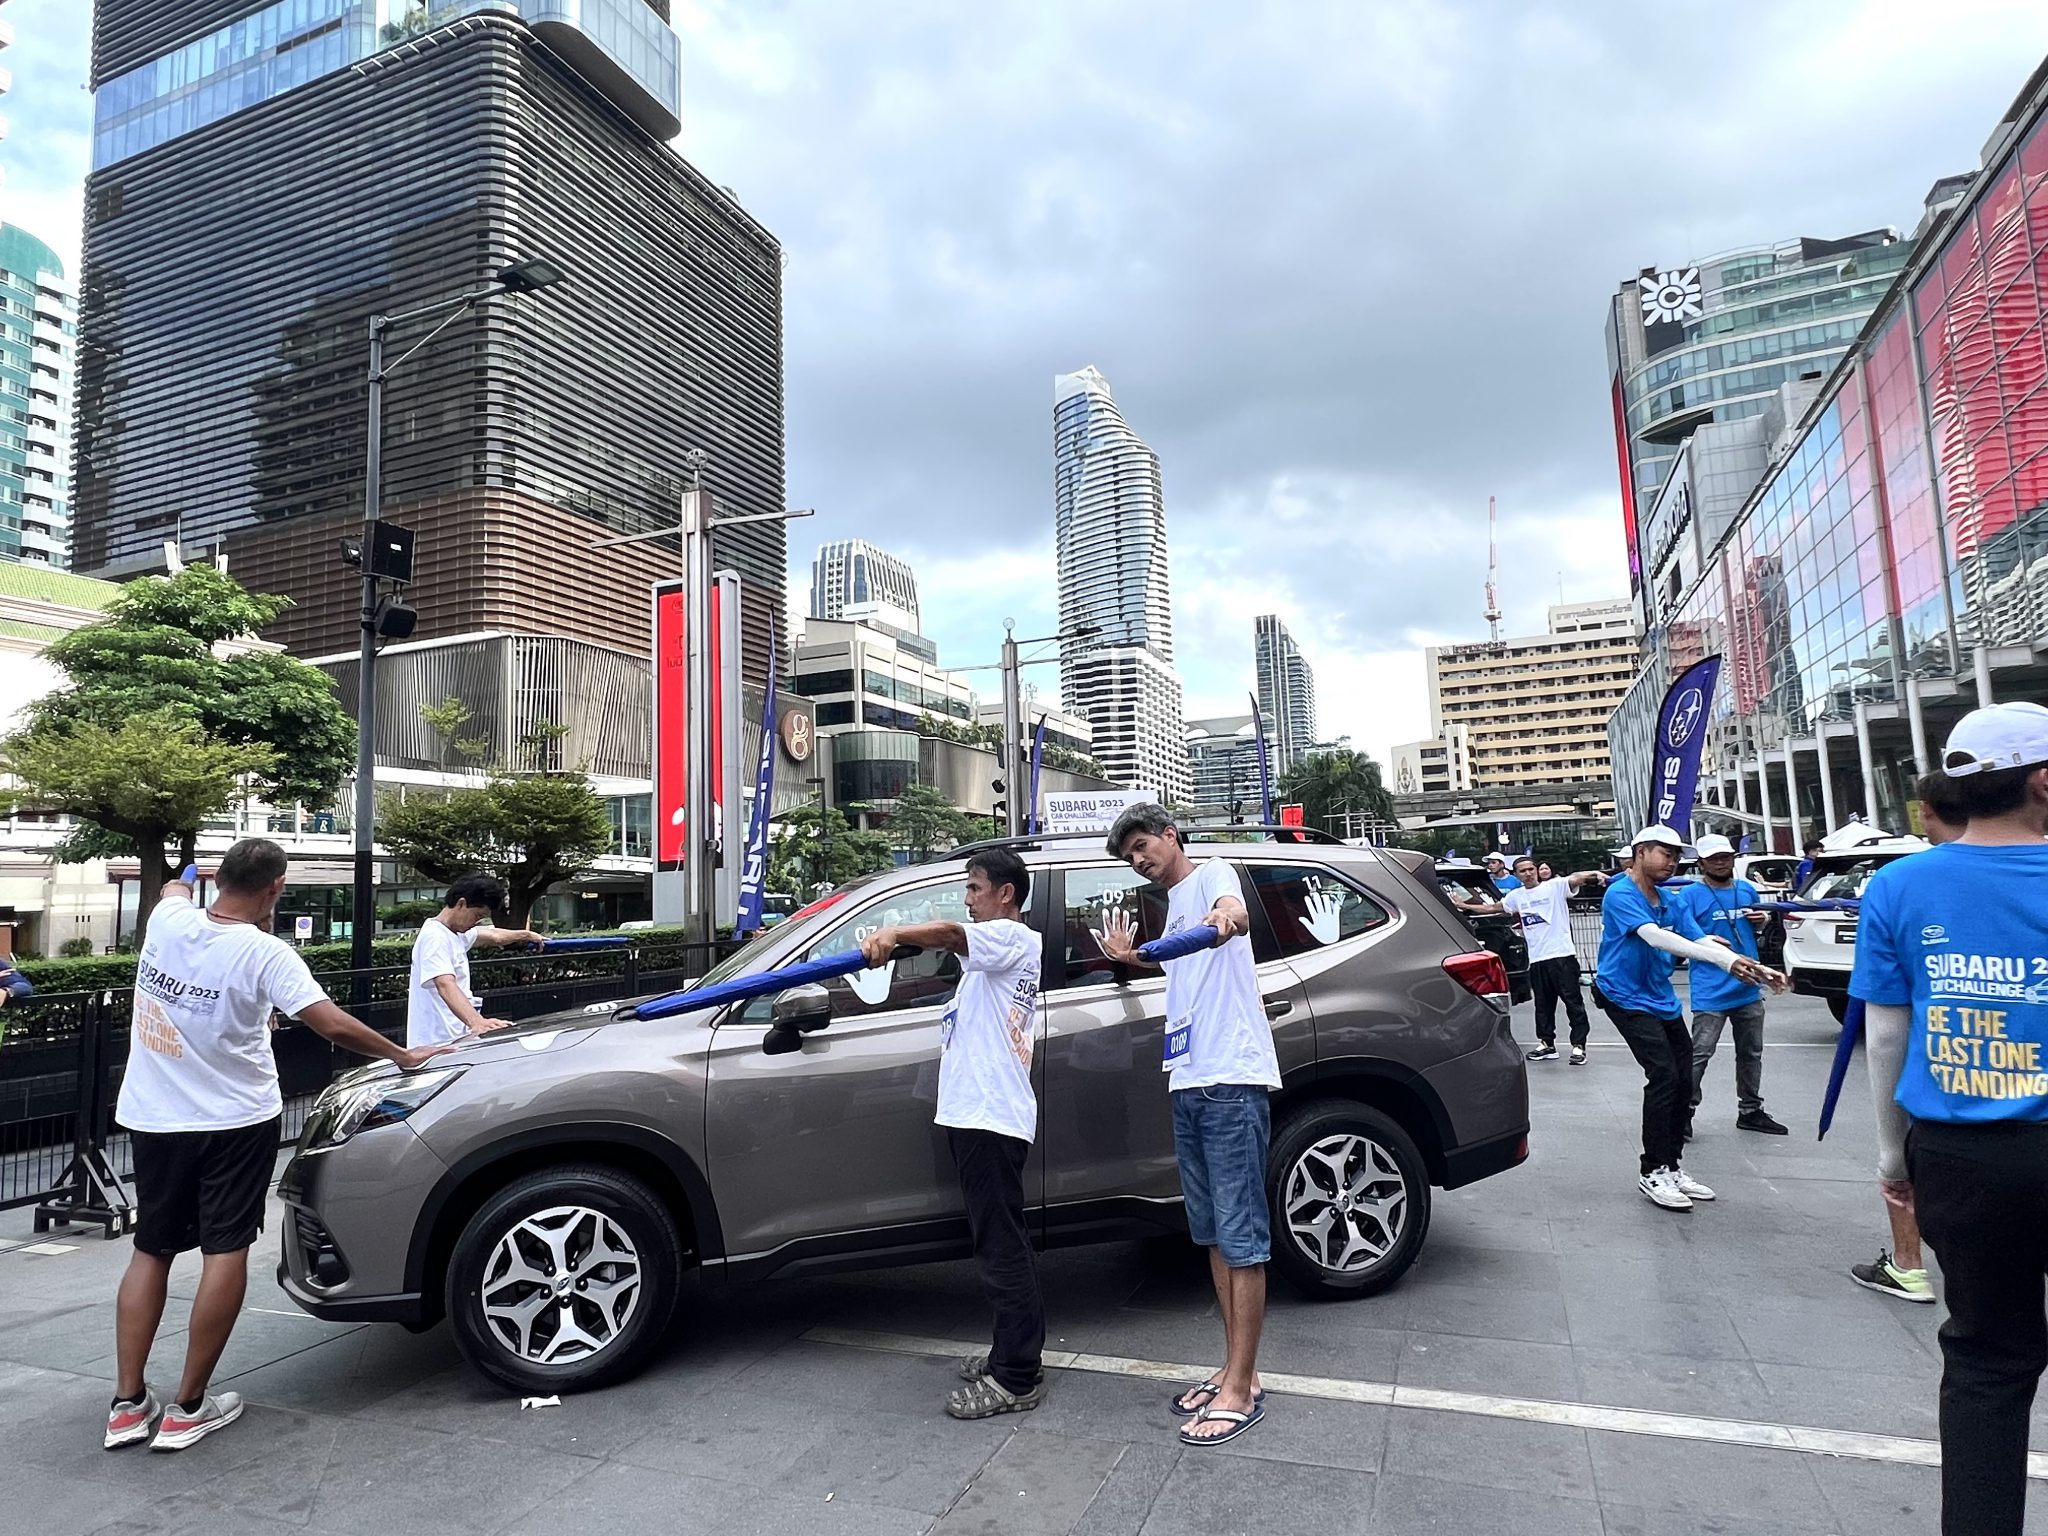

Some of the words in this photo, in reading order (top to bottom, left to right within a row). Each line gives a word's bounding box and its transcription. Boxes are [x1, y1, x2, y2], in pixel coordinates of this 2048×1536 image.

[1657, 756, 1681, 825] SUB
[1049, 800, 1096, 813] SUBARU
[1099, 799, 1124, 807] 2023
[1064, 811, 1097, 819] CHALLENGE
[1103, 888, 1124, 906] 09
[140, 959, 187, 996] SUBARU
[188, 985, 221, 1000] 2023
[1925, 953, 2026, 982] SUBARU
[1944, 979, 2026, 998] CHALLENGE
[146, 998, 164, 1022] THE
[1927, 1005, 1952, 1033] BE
[1956, 1007, 2009, 1039] THE
[137, 1026, 183, 1058] ANDING
[157, 1022, 180, 1042] ONE
[1170, 1031, 1188, 1054] 0109
[1926, 1034, 1984, 1067] LAST
[1989, 1040, 2043, 1071] ONE
[1929, 1063, 2048, 1099] STANDING
